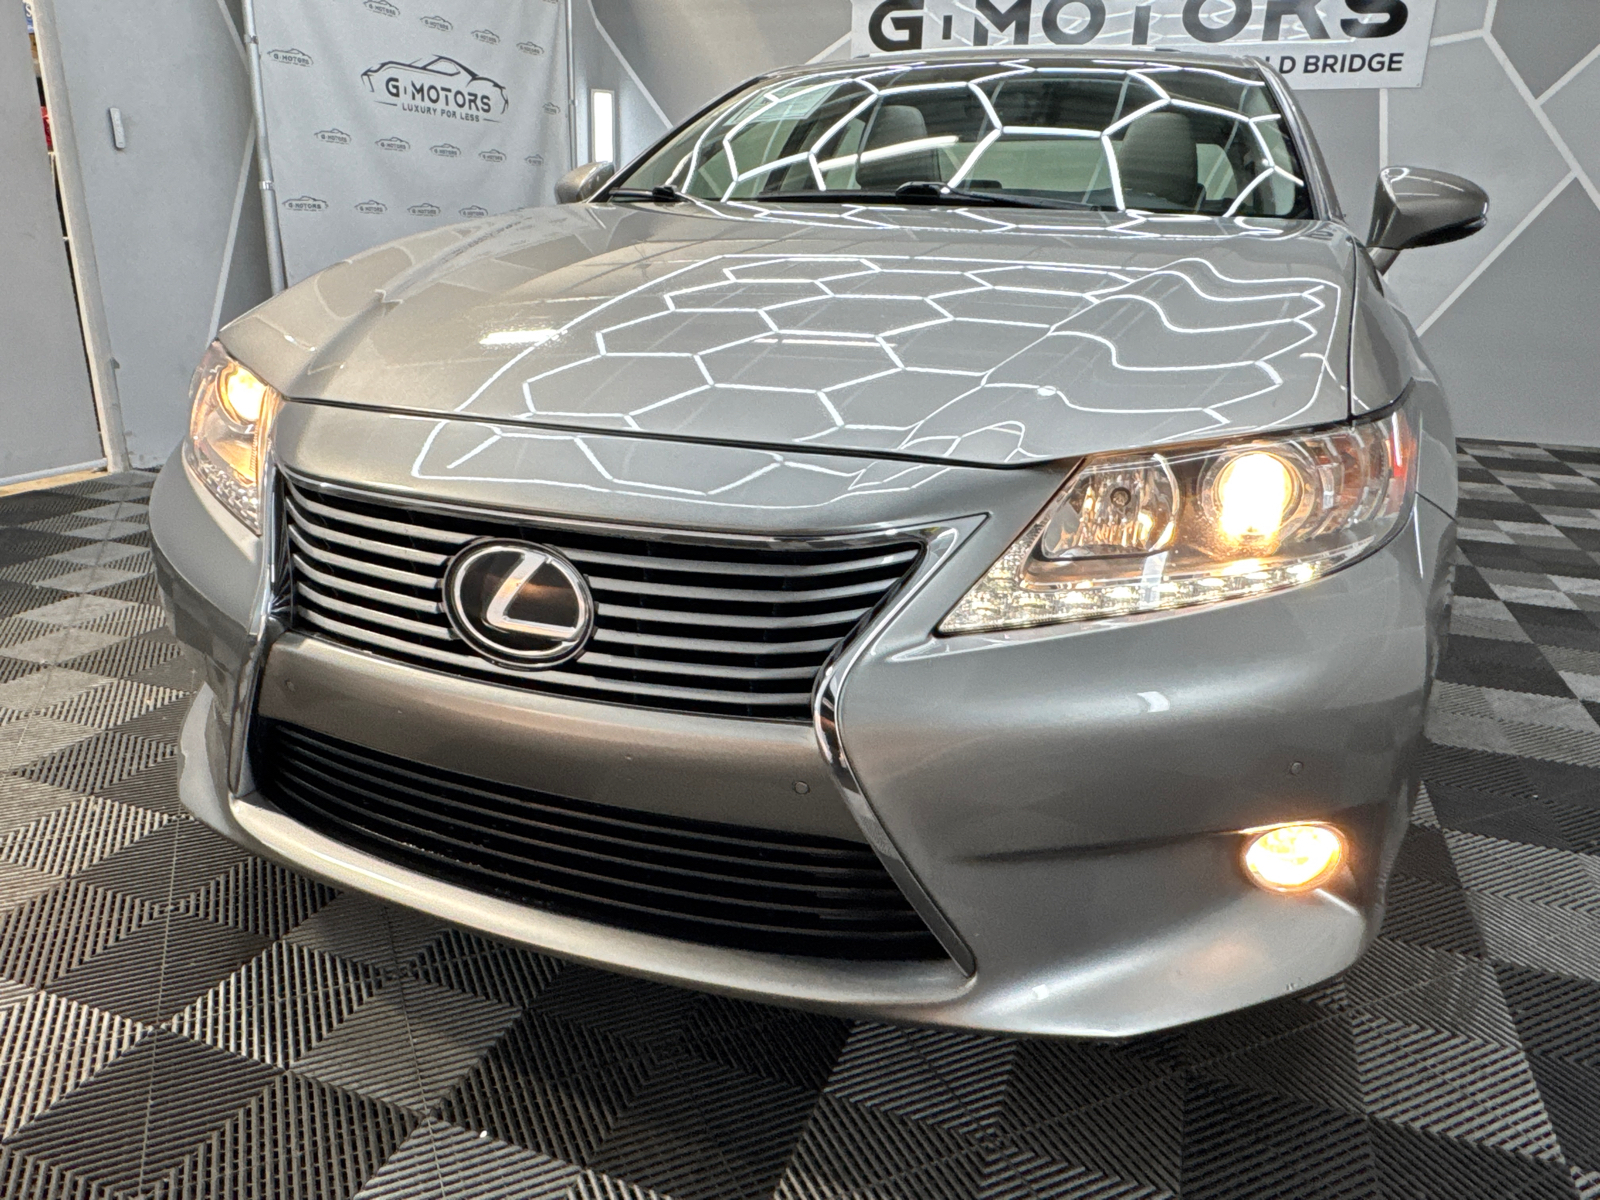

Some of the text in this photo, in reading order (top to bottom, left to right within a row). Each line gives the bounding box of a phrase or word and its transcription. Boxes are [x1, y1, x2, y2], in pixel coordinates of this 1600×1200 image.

[1302, 52, 1404, 74] BRIDGE
[402, 102, 437, 116] LUXURY
[460, 112, 480, 122] LESS
